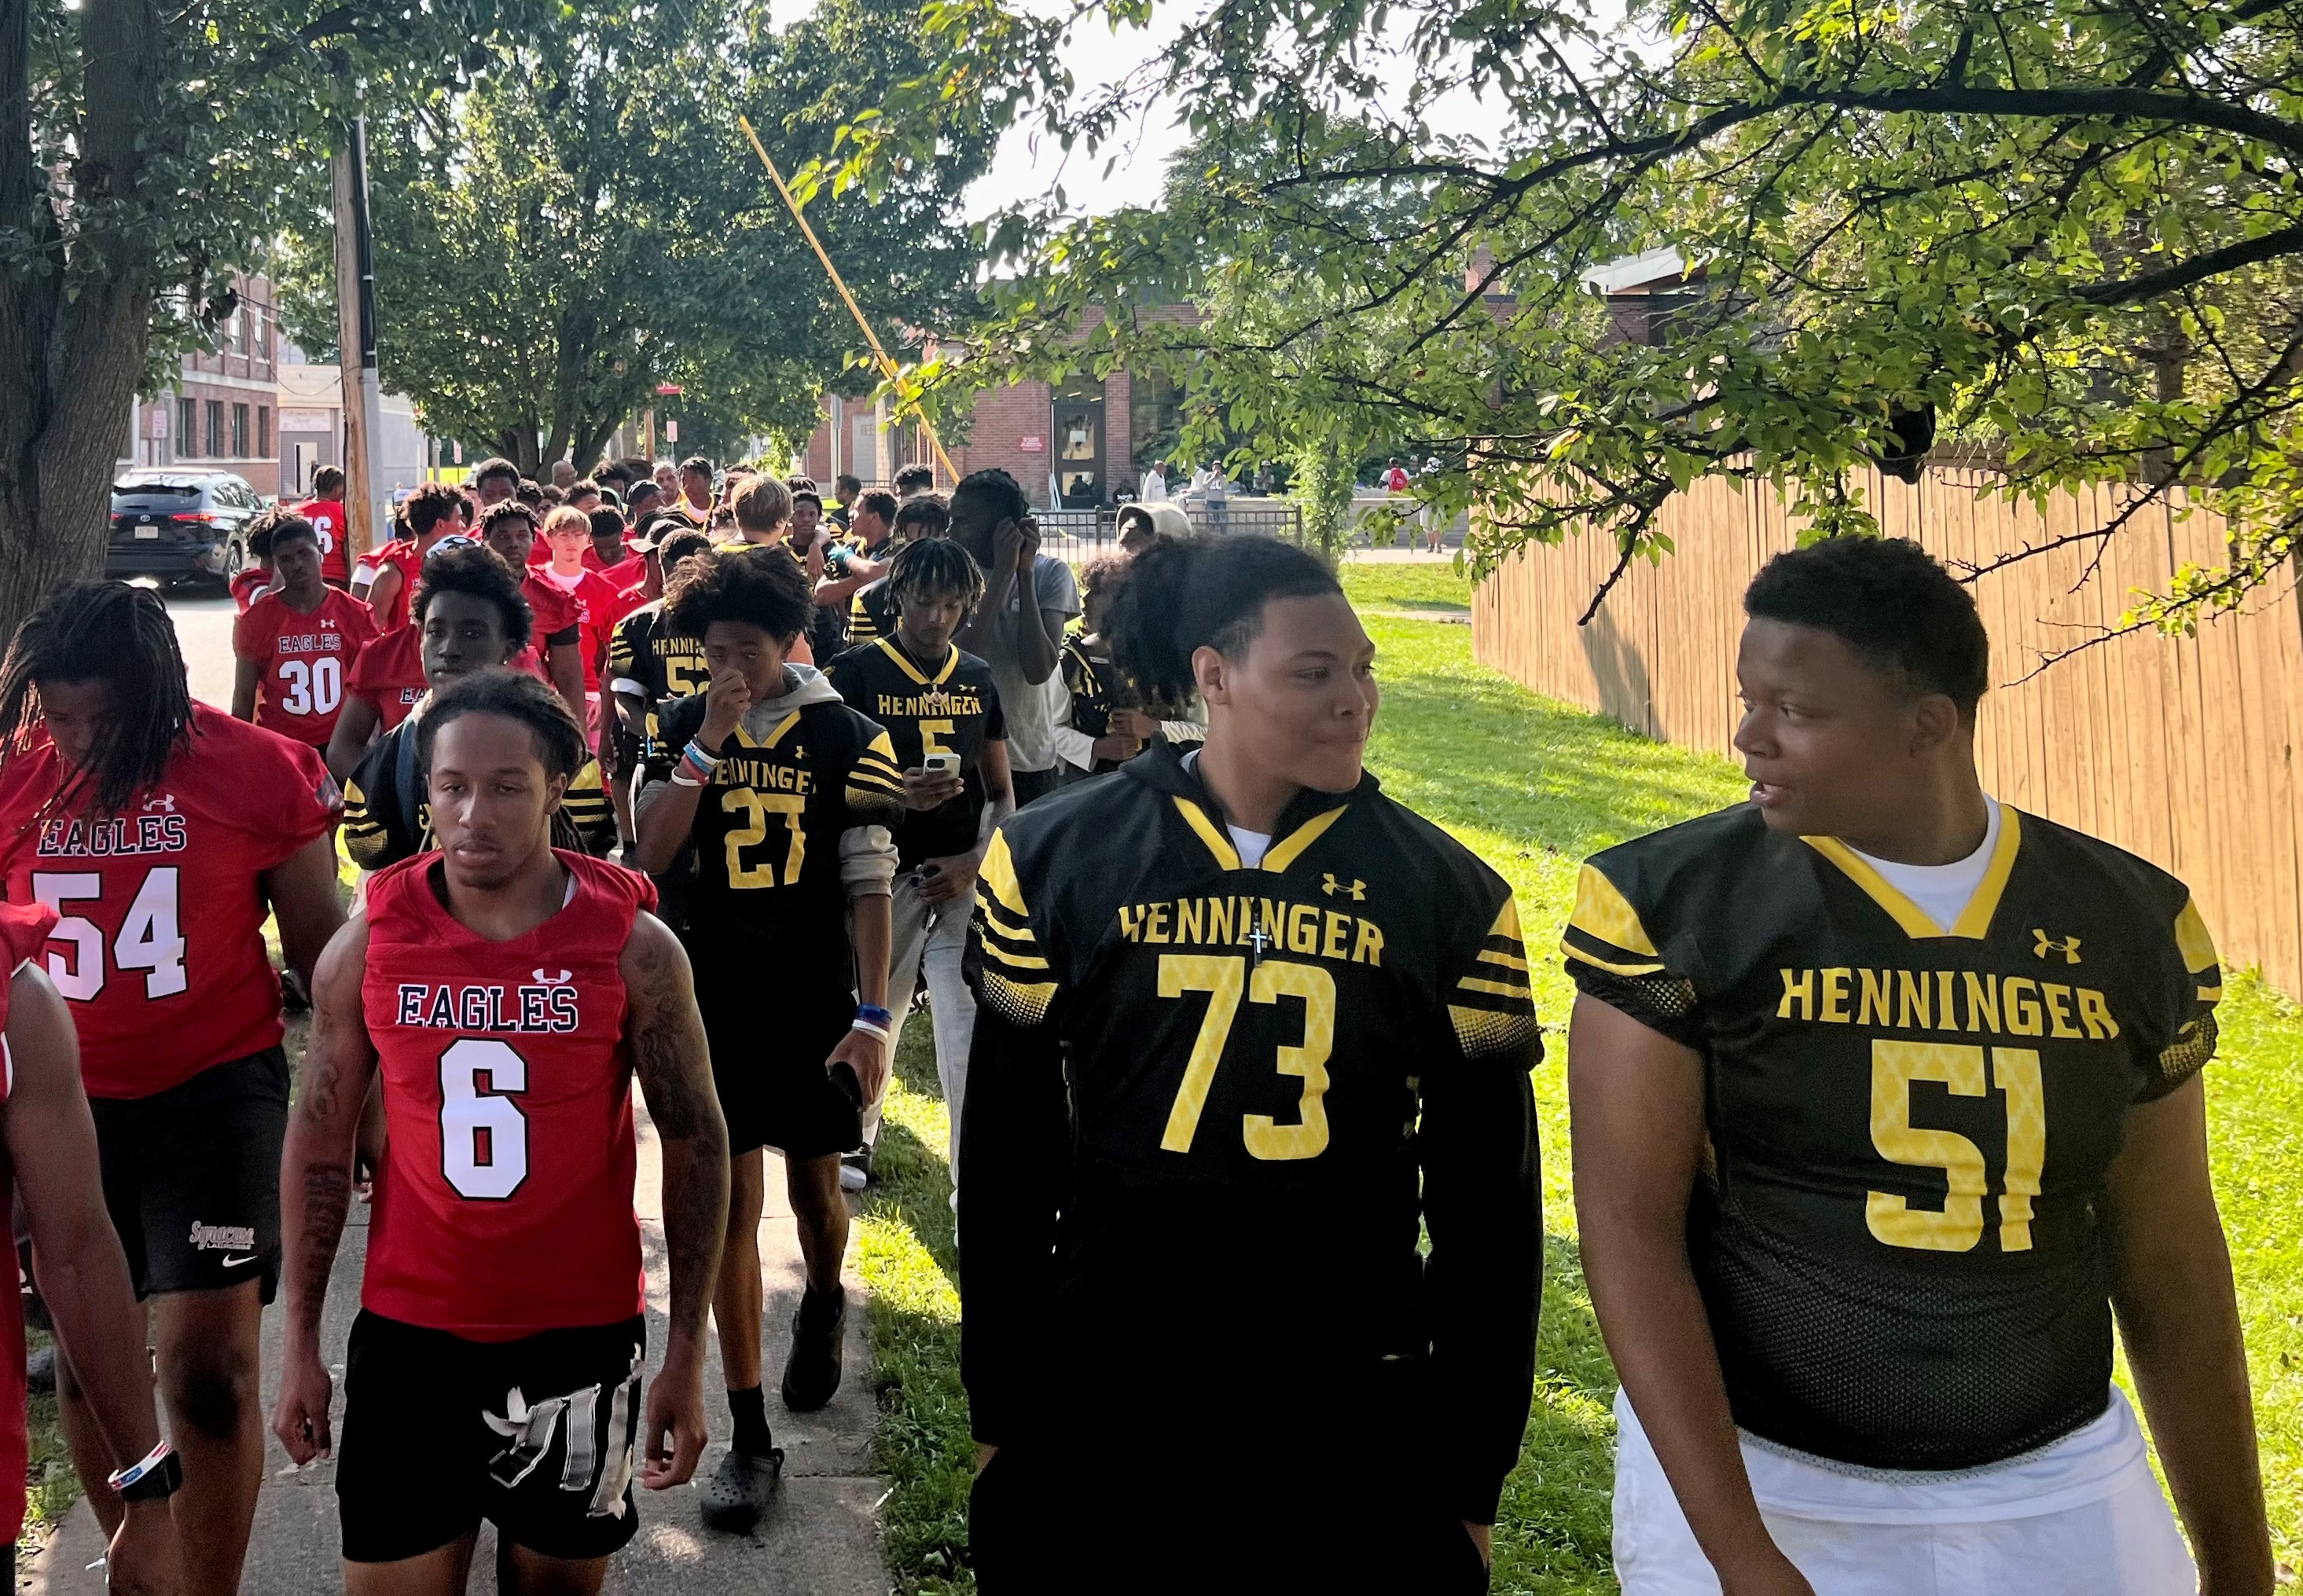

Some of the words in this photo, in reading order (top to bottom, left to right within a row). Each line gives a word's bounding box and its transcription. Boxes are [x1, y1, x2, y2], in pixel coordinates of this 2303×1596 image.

[307, 516, 333, 554] 6
[279, 633, 341, 654] EAGLES
[279, 656, 342, 715] 30
[710, 757, 817, 795] ENNINGE
[36, 814, 187, 857] EAGLES
[721, 787, 806, 889] 27
[31, 865, 188, 1003] 54
[1118, 896, 1385, 967] HENNINGER
[395, 984, 579, 1033] EAGLES
[1776, 967, 2121, 1040] HENNINGER
[1157, 953, 1336, 1161] 73
[437, 1036, 530, 1202] 6
[1865, 1038, 2046, 1253] 51
